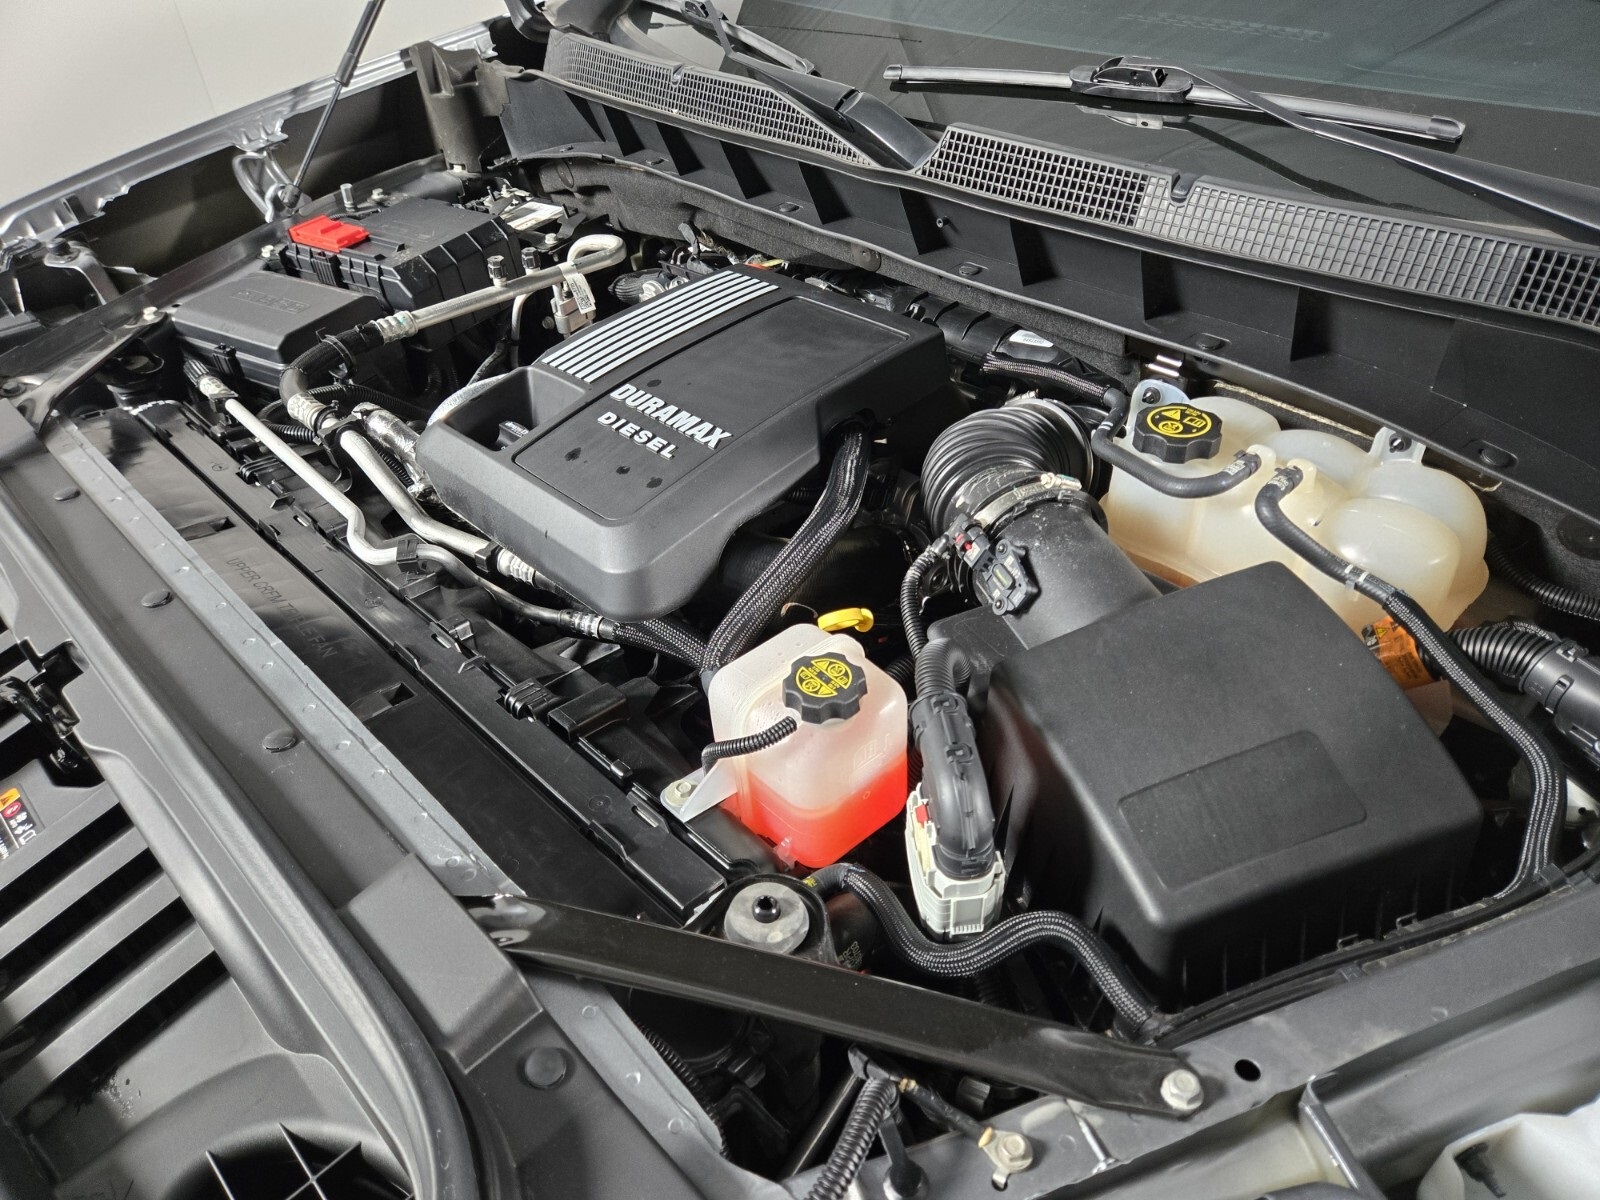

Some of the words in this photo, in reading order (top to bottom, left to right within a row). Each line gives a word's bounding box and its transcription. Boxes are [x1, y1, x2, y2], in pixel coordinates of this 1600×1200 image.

[597, 411, 679, 460] DIESEL
[610, 384, 732, 450] DURAMAX
[226, 558, 261, 583] UPPER
[308, 635, 338, 659] FAN
